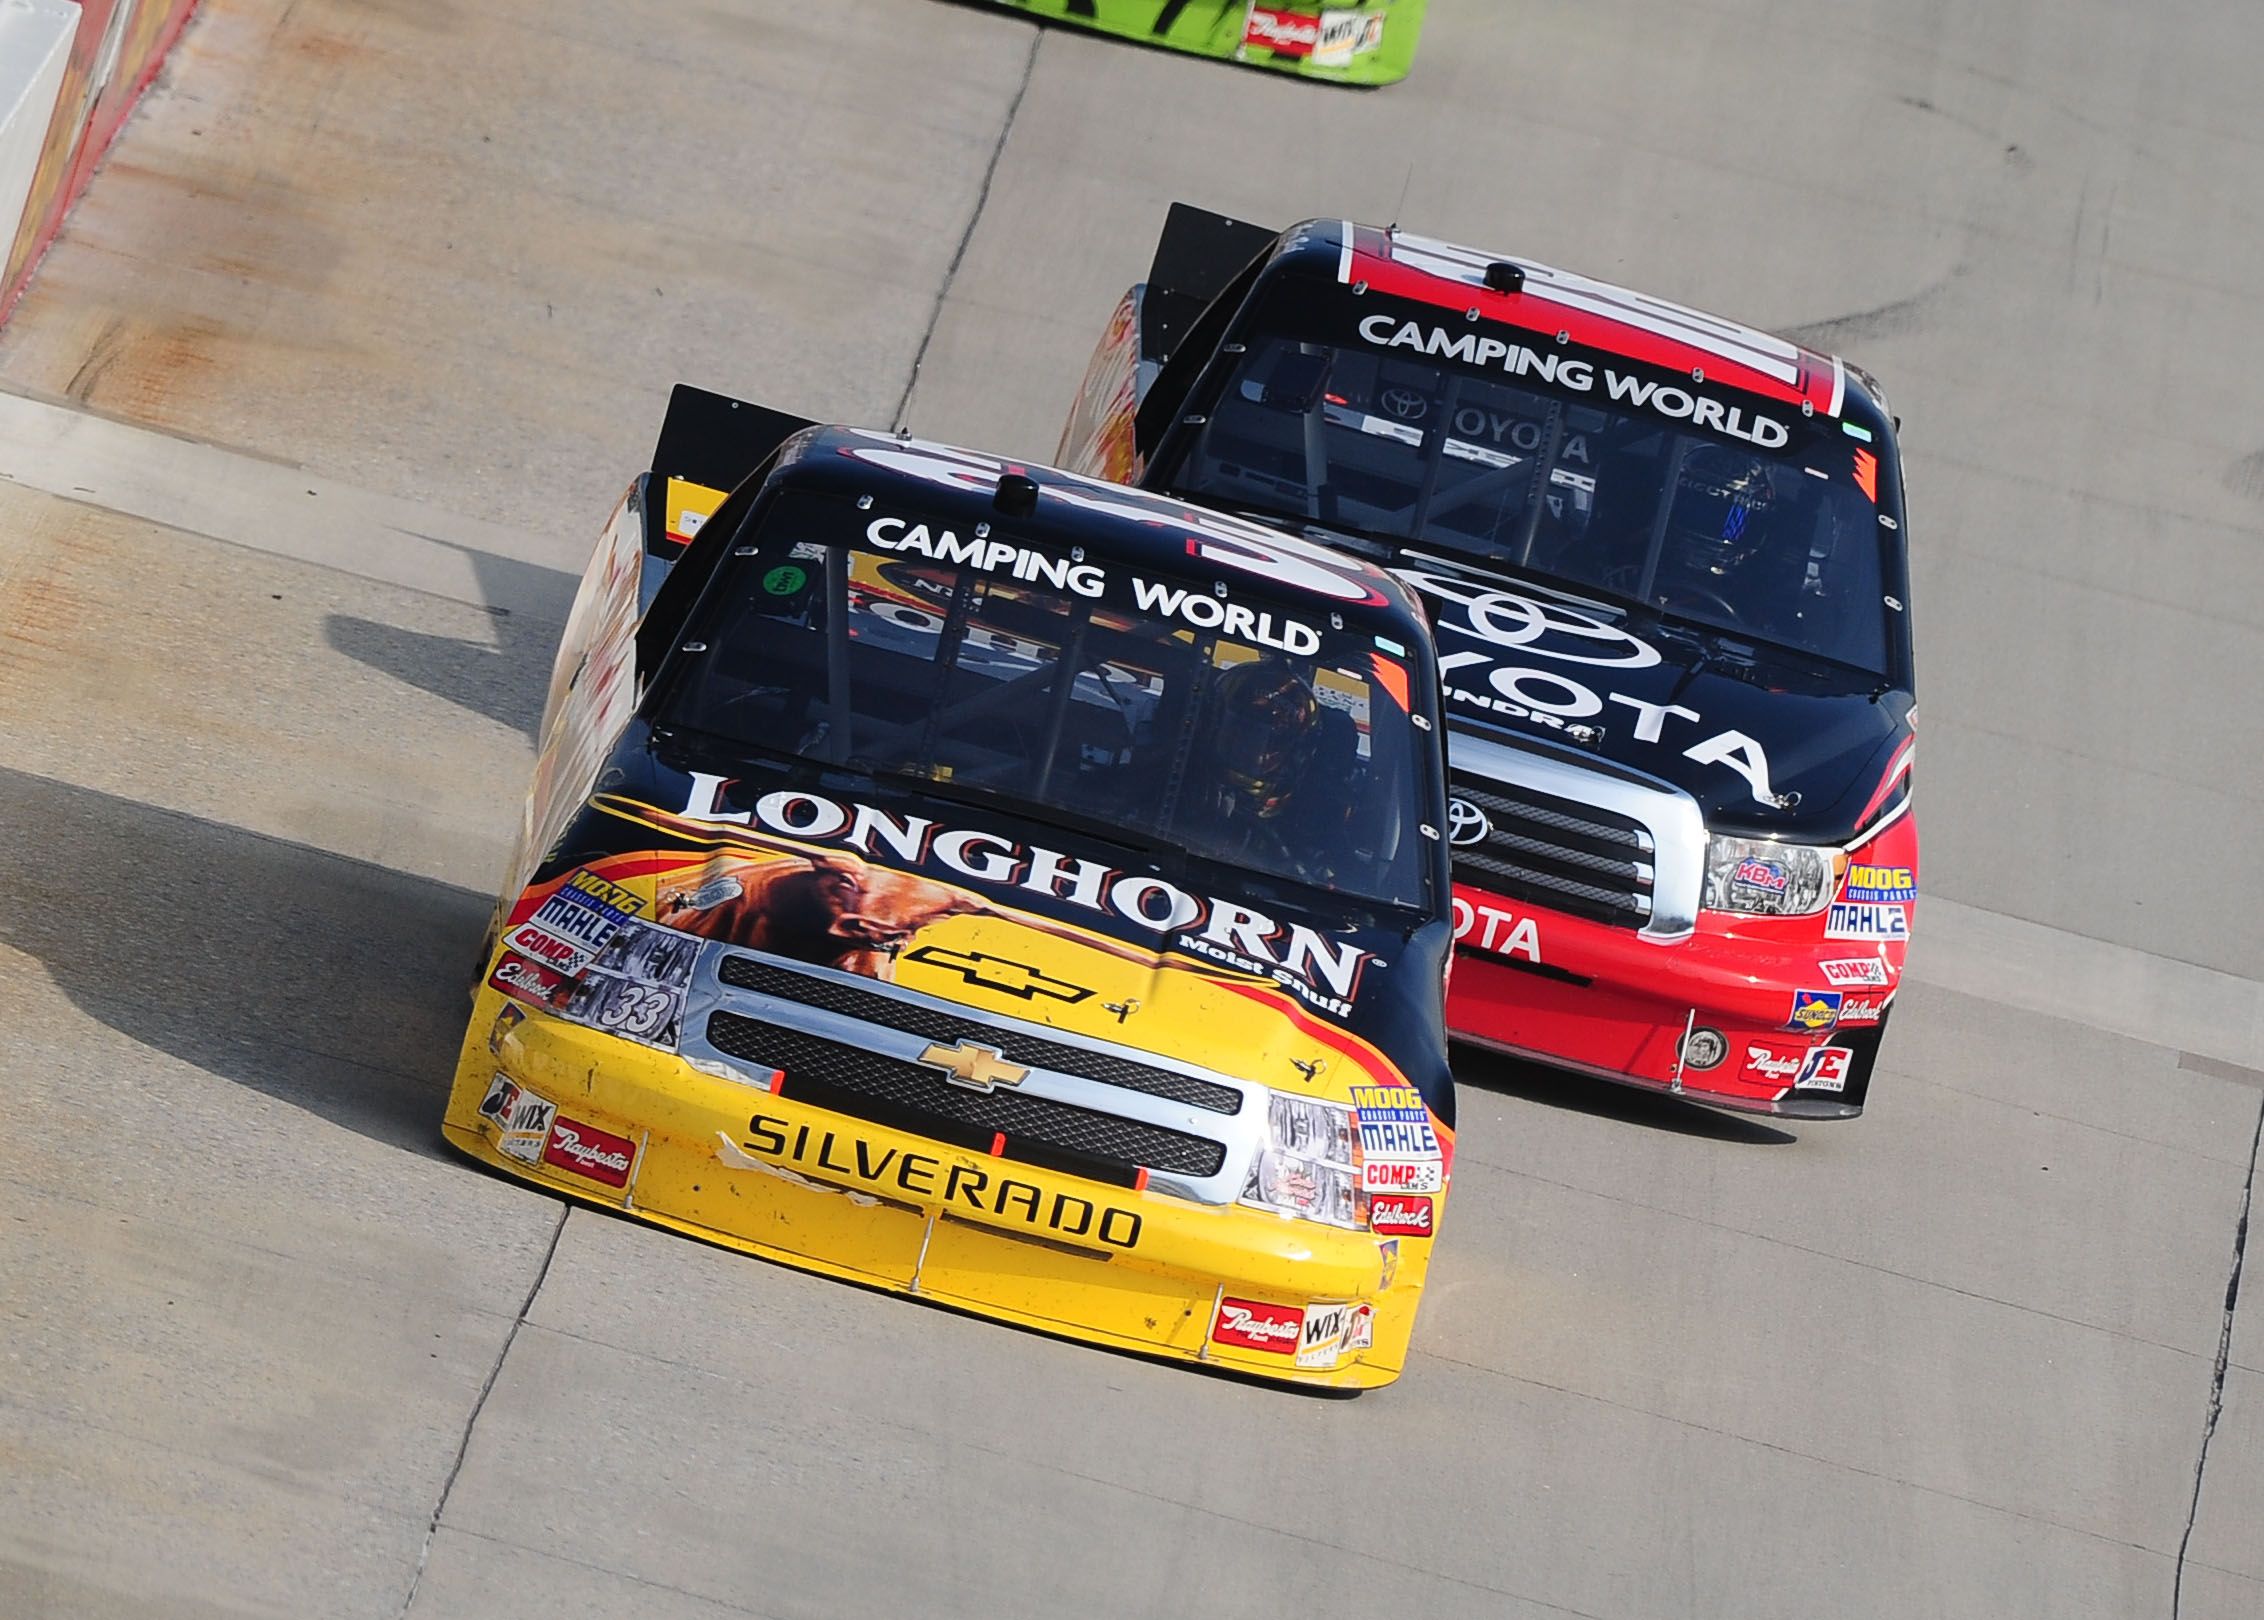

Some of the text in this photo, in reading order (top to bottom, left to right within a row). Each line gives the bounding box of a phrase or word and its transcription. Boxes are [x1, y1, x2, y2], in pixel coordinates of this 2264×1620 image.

[1358, 315, 1789, 448] CAMPING WORLD
[866, 517, 1105, 597] CAMPING
[1132, 577, 1319, 656] WORLD
[680, 771, 1368, 999] LONGHORN
[1848, 865, 1912, 889] MOOG
[515, 928, 575, 962] COMP
[537, 899, 619, 947] MAHLE
[1179, 935, 1352, 1018] Moist Snuff
[1825, 962, 1870, 979] COMP
[601, 986, 672, 1032] 33
[1354, 1087, 1423, 1109] MOOG
[1360, 1123, 1437, 1152] MAHLE
[743, 1114, 1142, 1249] SILVERADO
[1367, 1164, 1416, 1185] COMP
